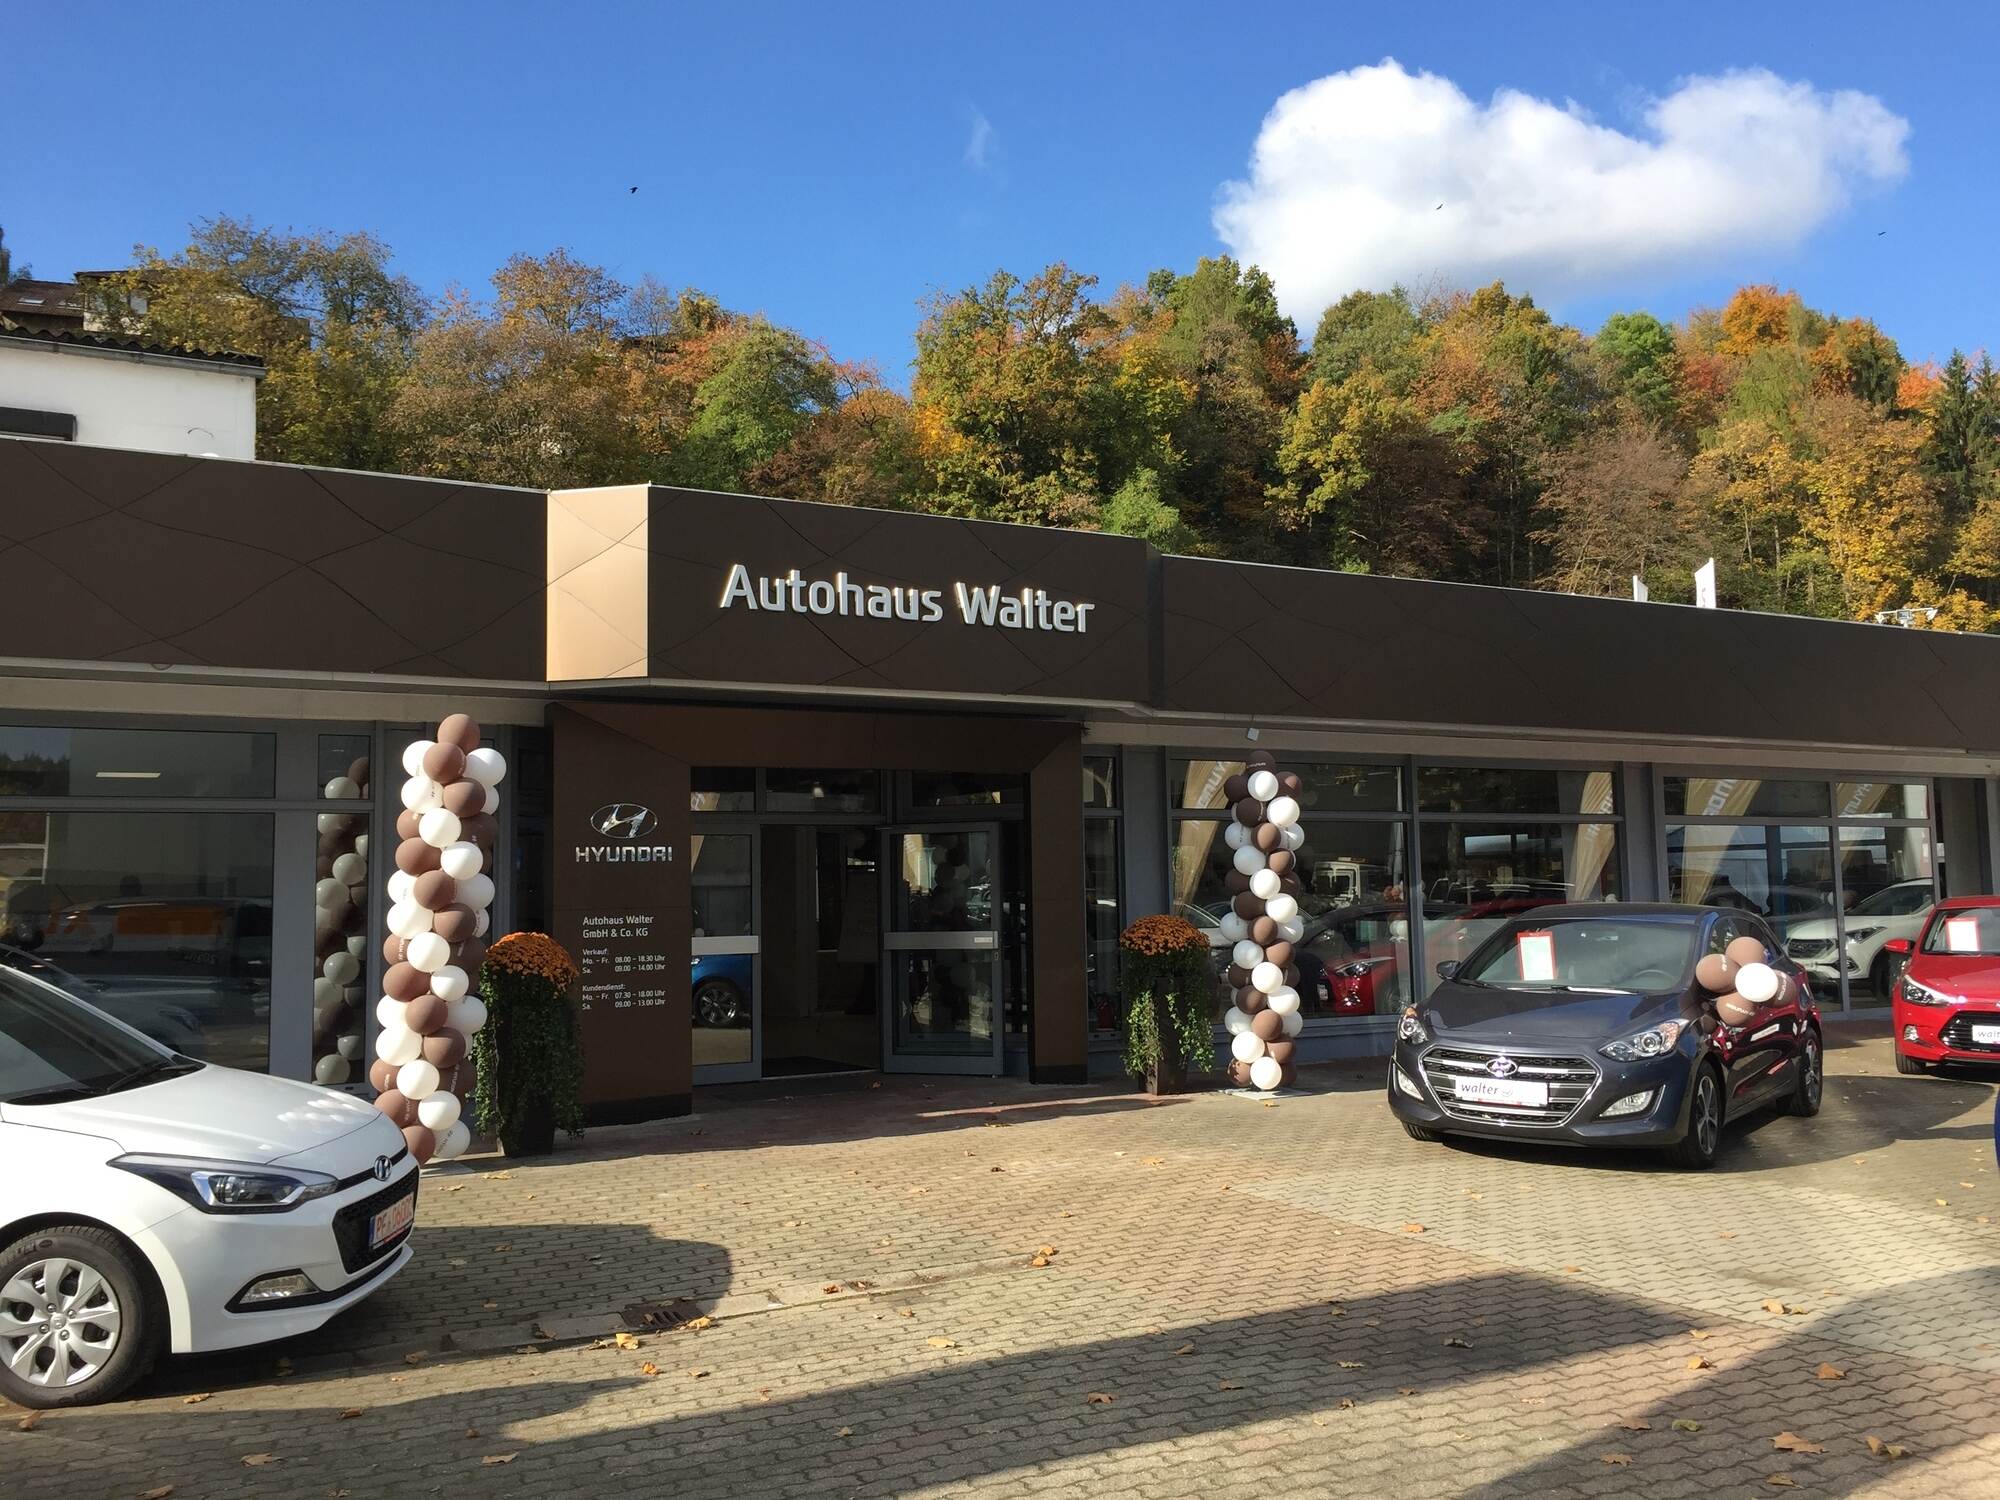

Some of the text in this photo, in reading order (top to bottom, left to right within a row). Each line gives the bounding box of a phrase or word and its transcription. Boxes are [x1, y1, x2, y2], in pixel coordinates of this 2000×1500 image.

[720, 564, 1095, 633] Autohaus Walter
[575, 846, 673, 863] HYUNDAI
[582, 915, 654, 926] Autohaus Walter
[582, 928, 649, 939] GmbH & Co. KG
[582, 966, 592, 974] Sa.
[582, 984, 626, 992] Kundendienst:
[1461, 1083, 1500, 1095] walter
